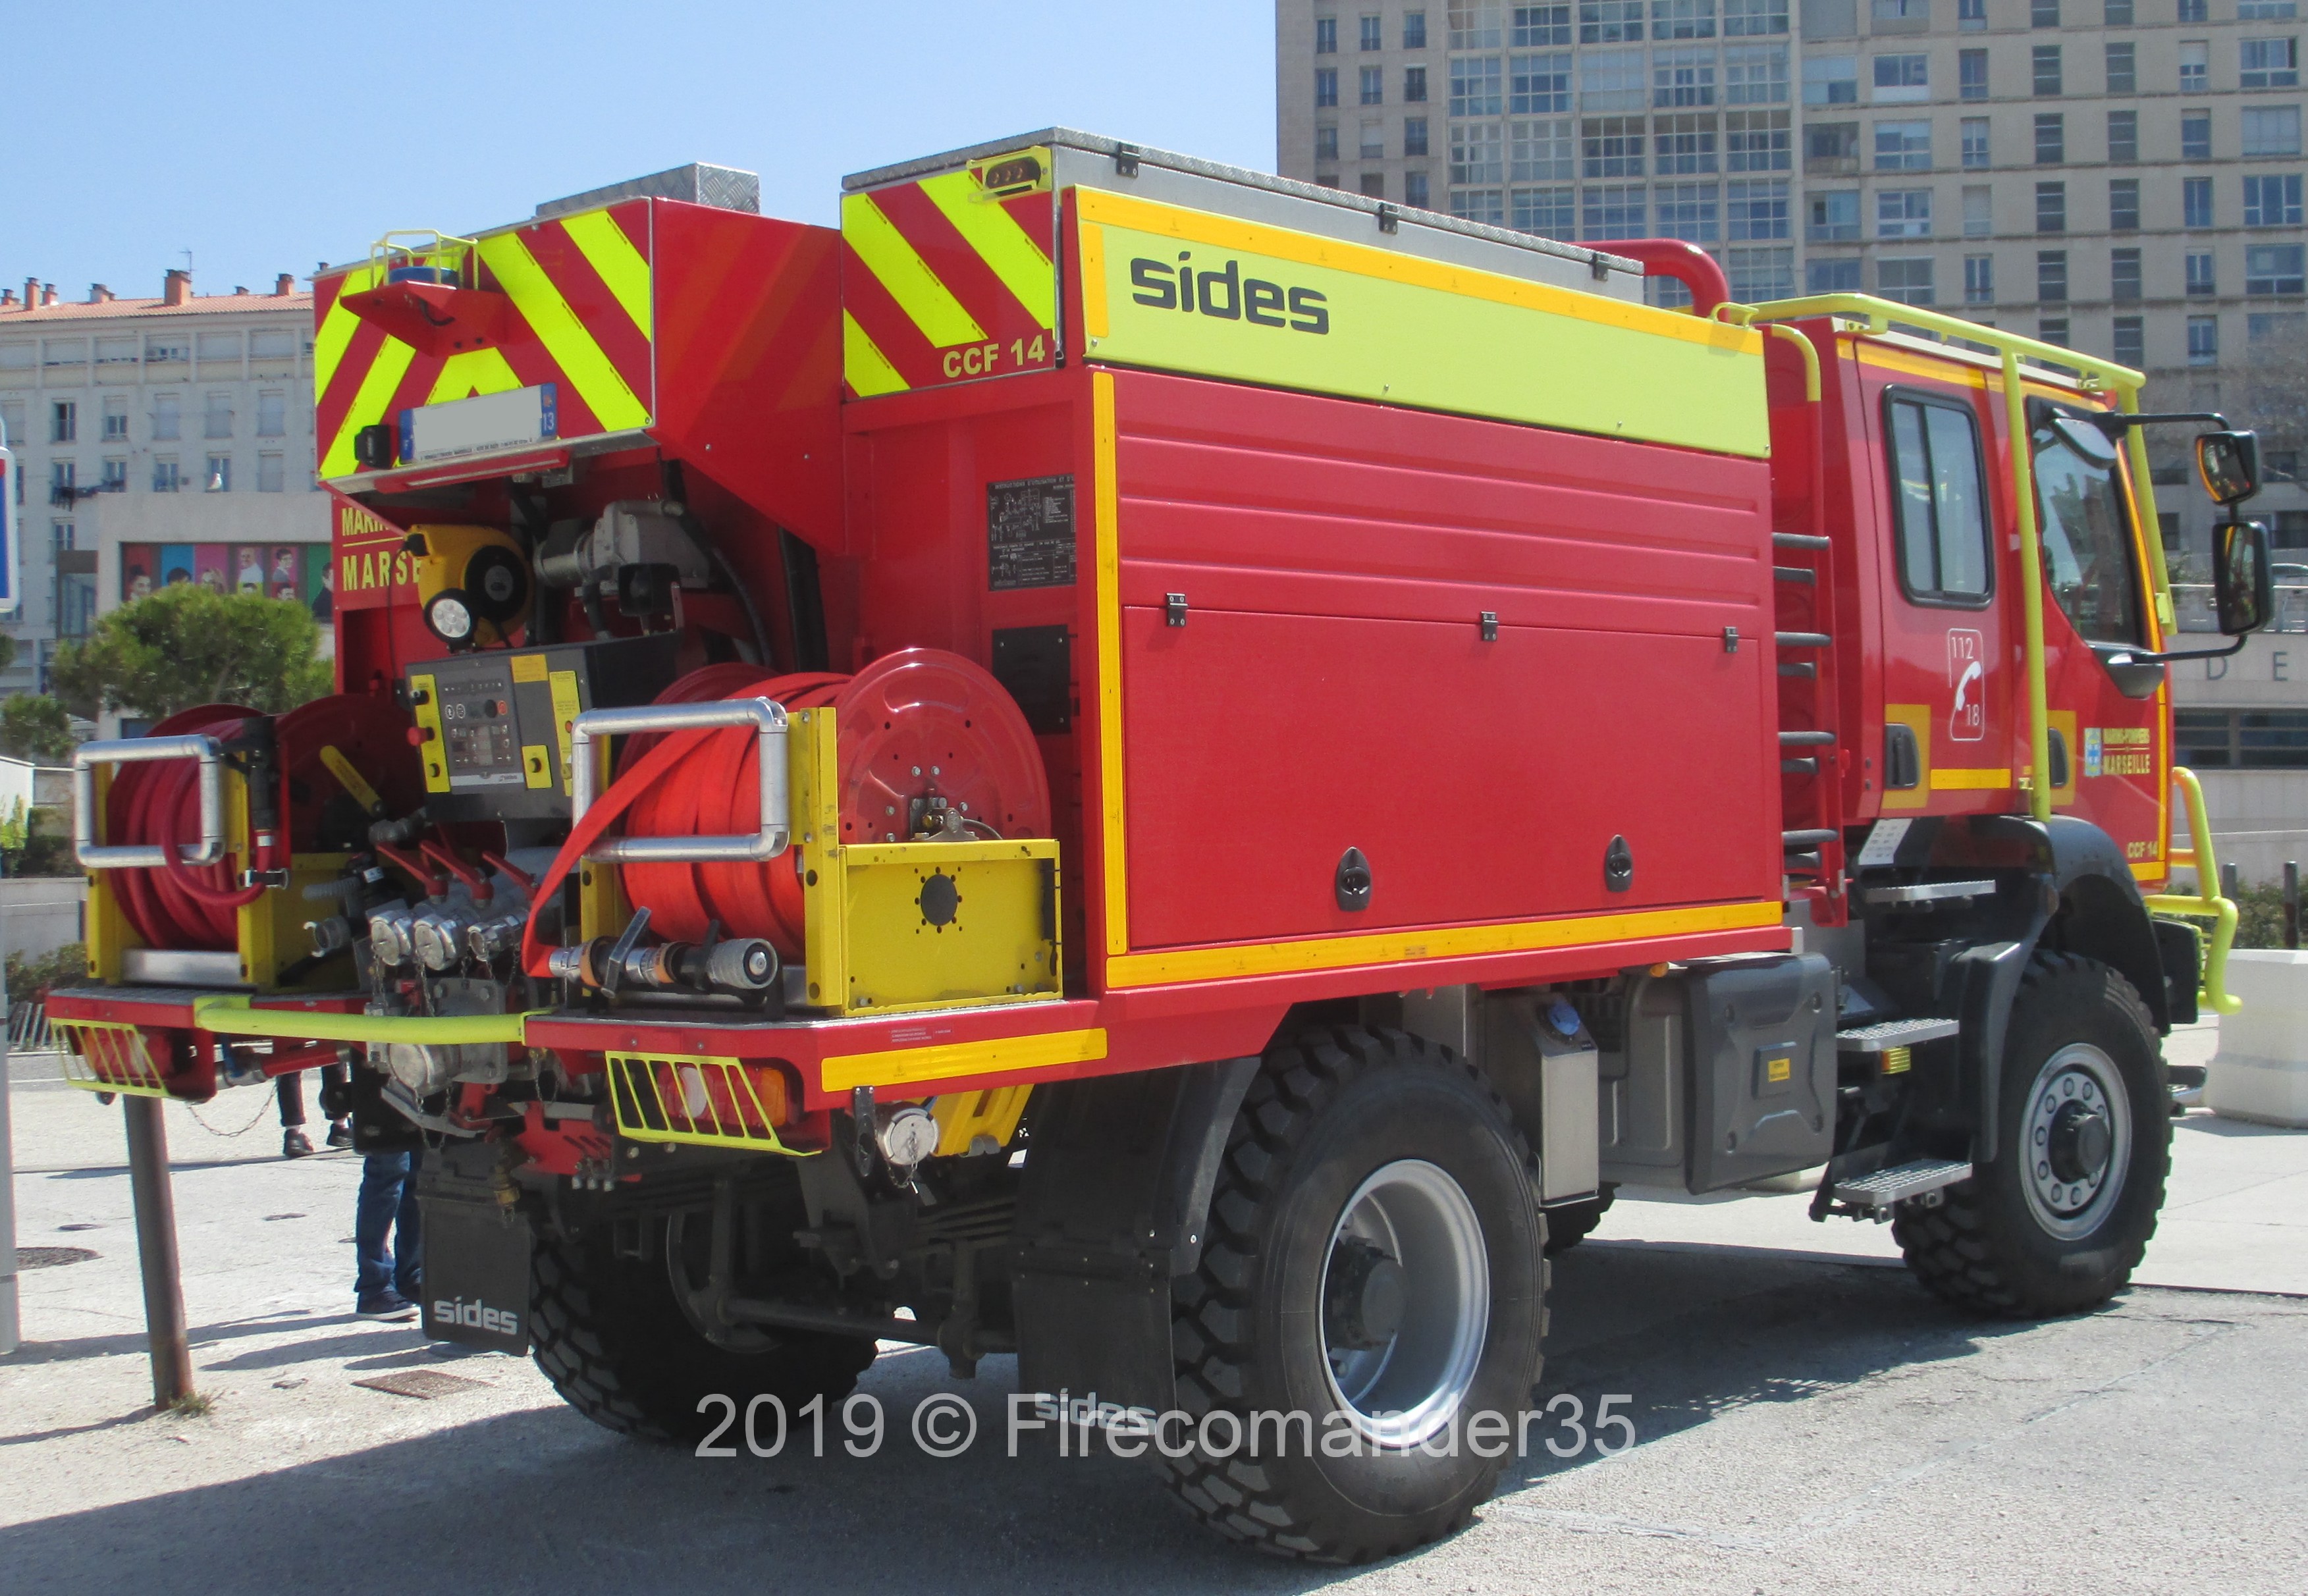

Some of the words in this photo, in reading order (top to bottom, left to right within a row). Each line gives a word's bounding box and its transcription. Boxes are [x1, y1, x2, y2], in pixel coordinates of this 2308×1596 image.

[1130, 251, 1329, 335] sides
[943, 343, 999, 378] CCF
[1011, 334, 1045, 366] 14
[542, 412, 554, 431] 13
[1951, 637, 1974, 659] 112
[1966, 704, 1979, 726] 18
[2103, 754, 2151, 775] MARSEILLE
[2128, 841, 2145, 859] CCF
[2148, 841, 2158, 857] 14
[433, 1295, 519, 1336] sides
[1034, 1387, 1158, 1436] sides
